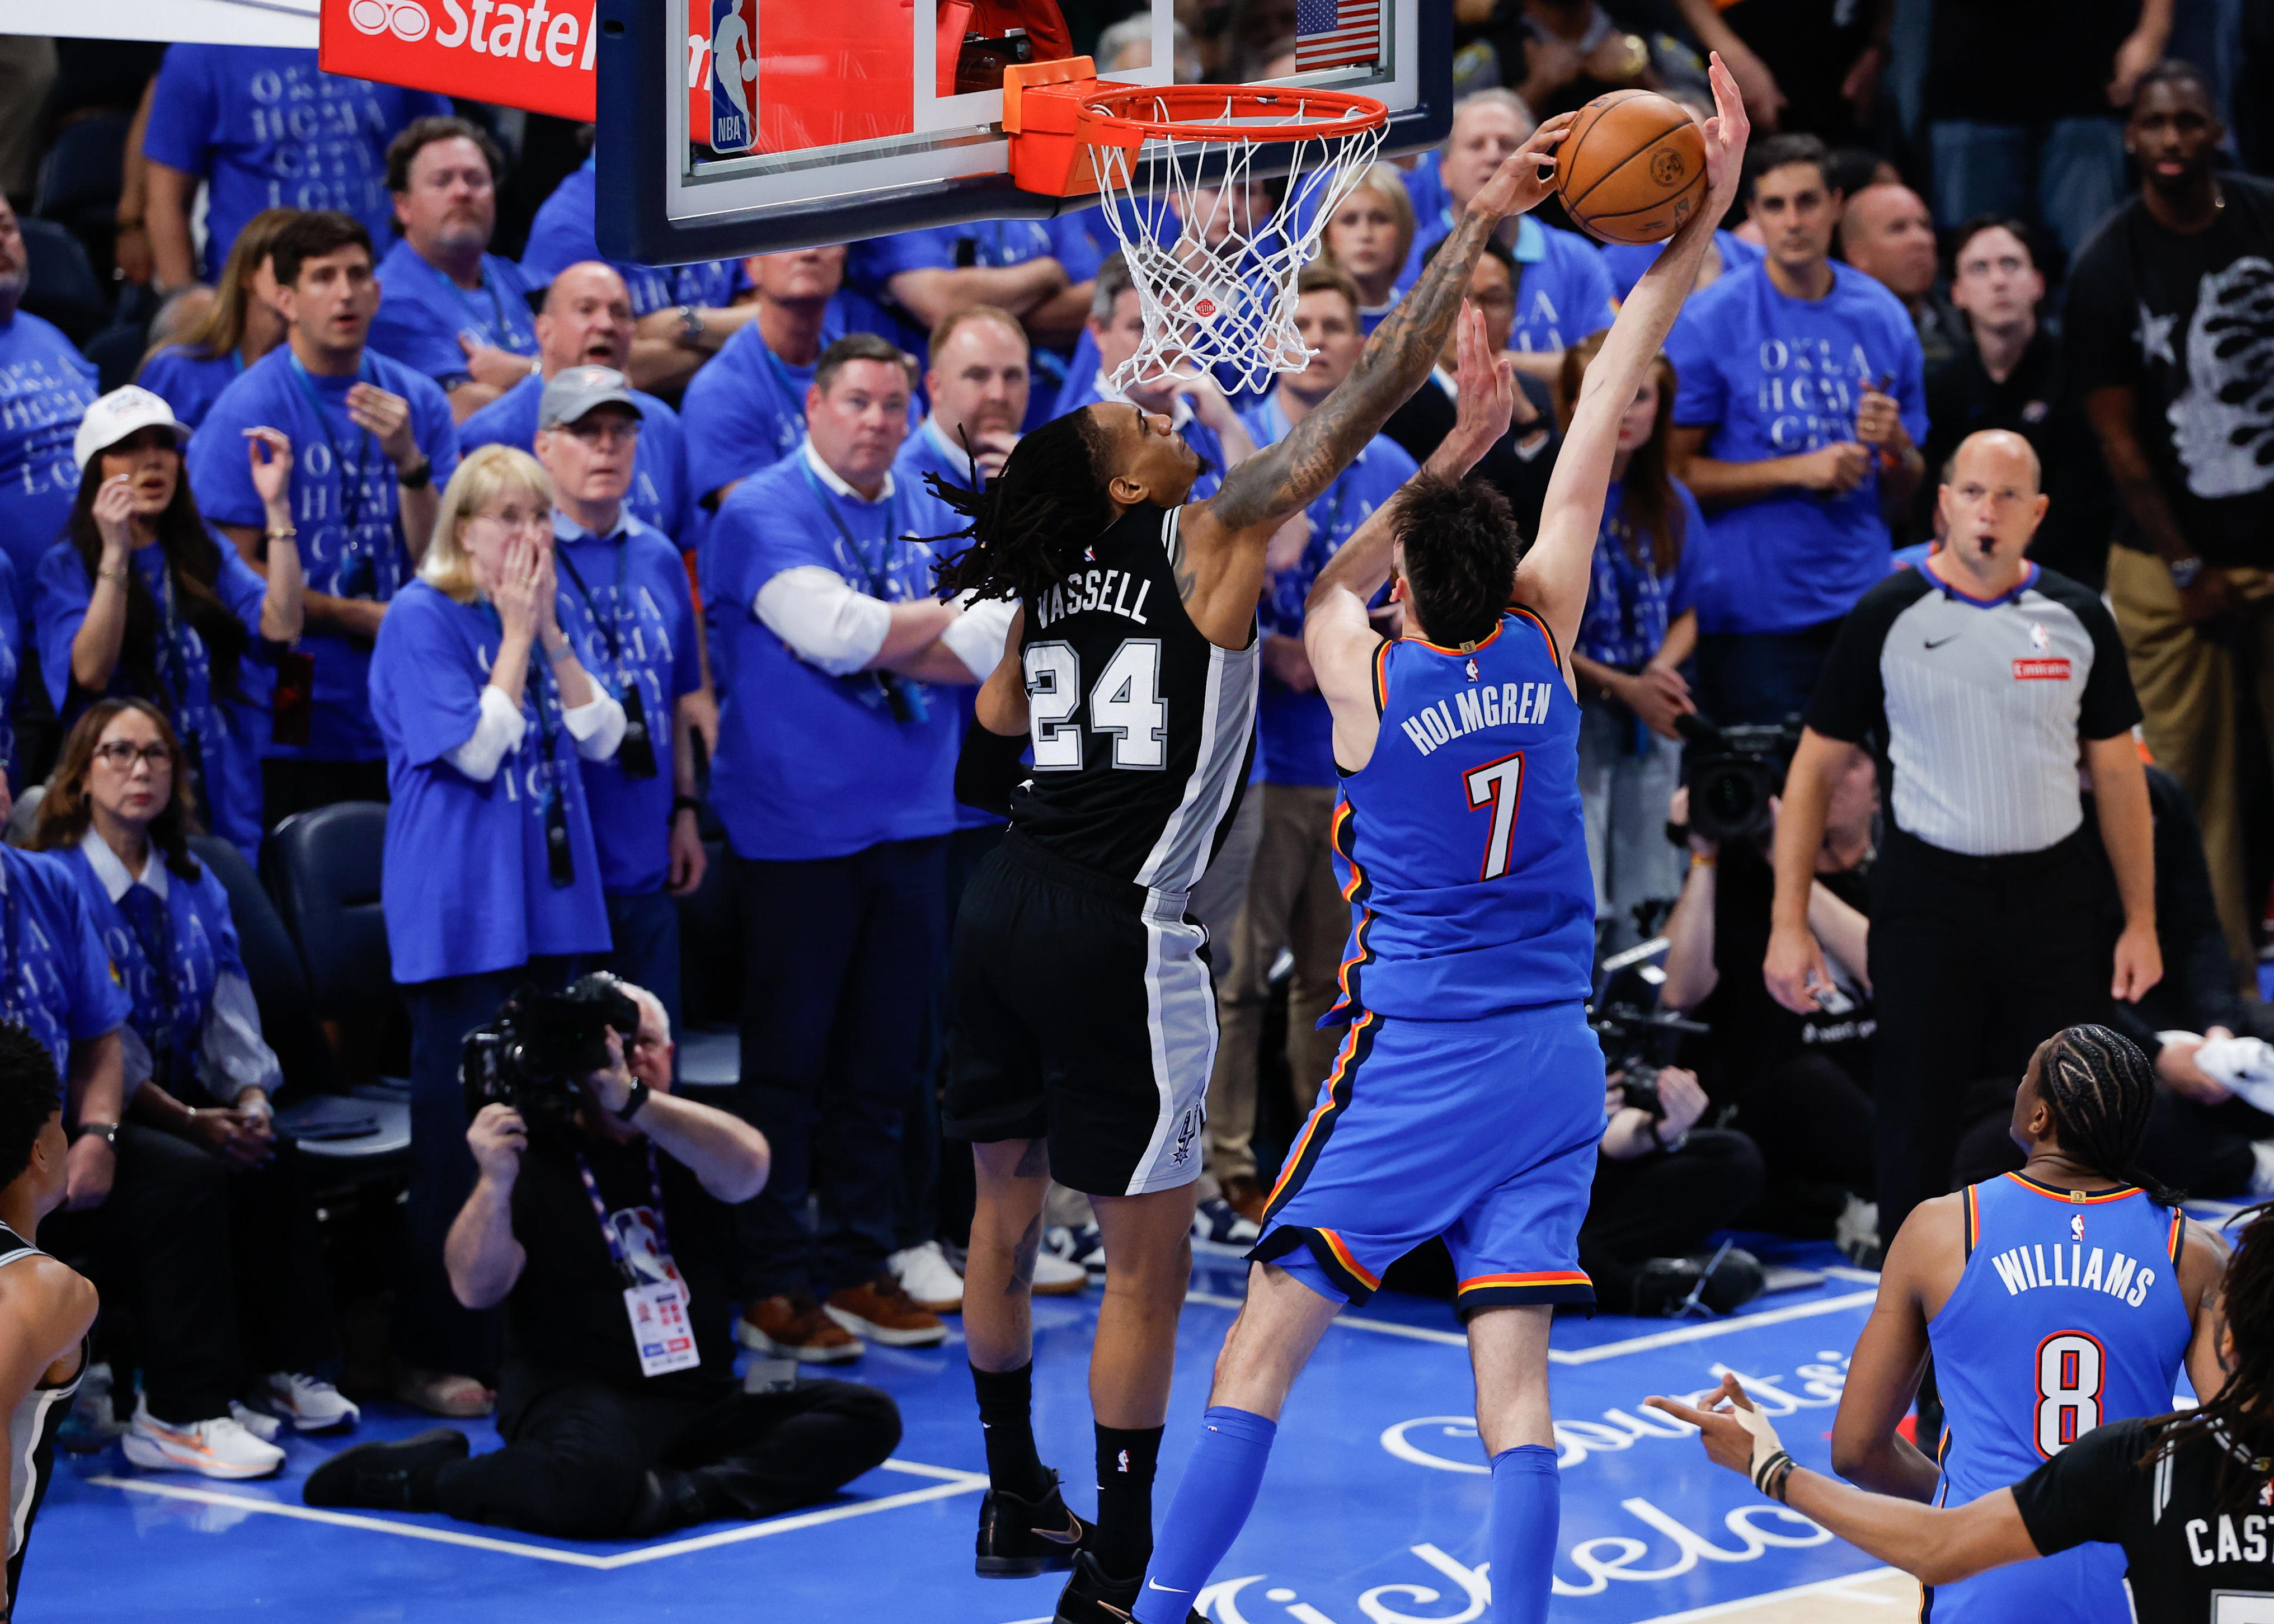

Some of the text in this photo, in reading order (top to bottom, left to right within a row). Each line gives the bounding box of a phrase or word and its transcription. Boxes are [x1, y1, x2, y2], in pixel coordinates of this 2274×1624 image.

[435, 0, 579, 68] State
[718, 115, 741, 142] NBA
[1037, 569, 1152, 629] VASSELL
[1024, 638, 1168, 771] 24
[1401, 682, 1552, 757] HOLMGREN
[1462, 750, 1525, 883] 7
[1991, 1243, 2155, 1308] WILLIAMS
[2034, 1329, 2106, 1461] 8
